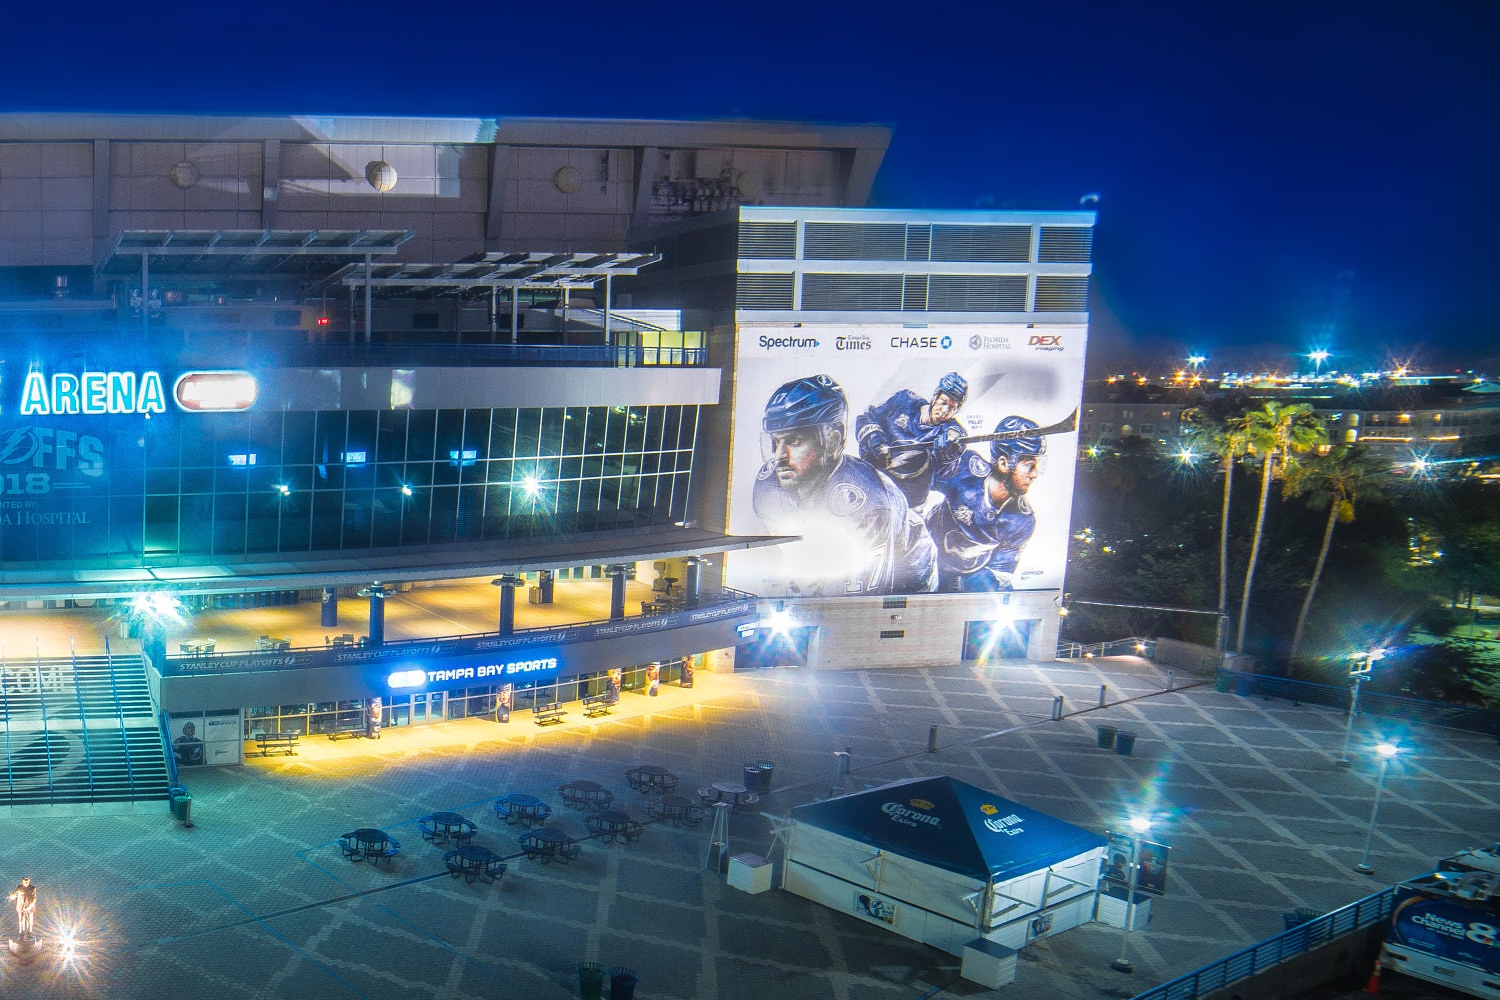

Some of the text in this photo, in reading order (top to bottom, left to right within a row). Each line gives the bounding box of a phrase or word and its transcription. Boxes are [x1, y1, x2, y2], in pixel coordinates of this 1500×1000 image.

[759, 335, 817, 350] Spectrum
[835, 336, 872, 351] Times
[890, 337, 938, 348] CHASE
[1028, 335, 1062, 346] DEX
[20, 371, 167, 415] ARENA
[17, 511, 91, 526] HOSPITAL
[477, 638, 509, 649] STANLEY
[509, 637, 524, 646] CUP
[523, 634, 558, 644] PLAYOFFS
[337, 651, 374, 661] STANLEY
[373, 649, 391, 658] CUP
[390, 647, 430, 656] PLAYOFFS
[180, 658, 283, 671] STANLEY CUP PLAYOFFS
[428, 657, 558, 682] TAMPA BAY SPORTS
[881, 801, 942, 826] Corona
[891, 813, 919, 828] Extra
[983, 813, 1024, 833] Corona
[1005, 827, 1025, 836] Extra
[1411, 914, 1466, 938] Channel
[1425, 912, 1465, 930] News
[1466, 921, 1498, 946] 8
